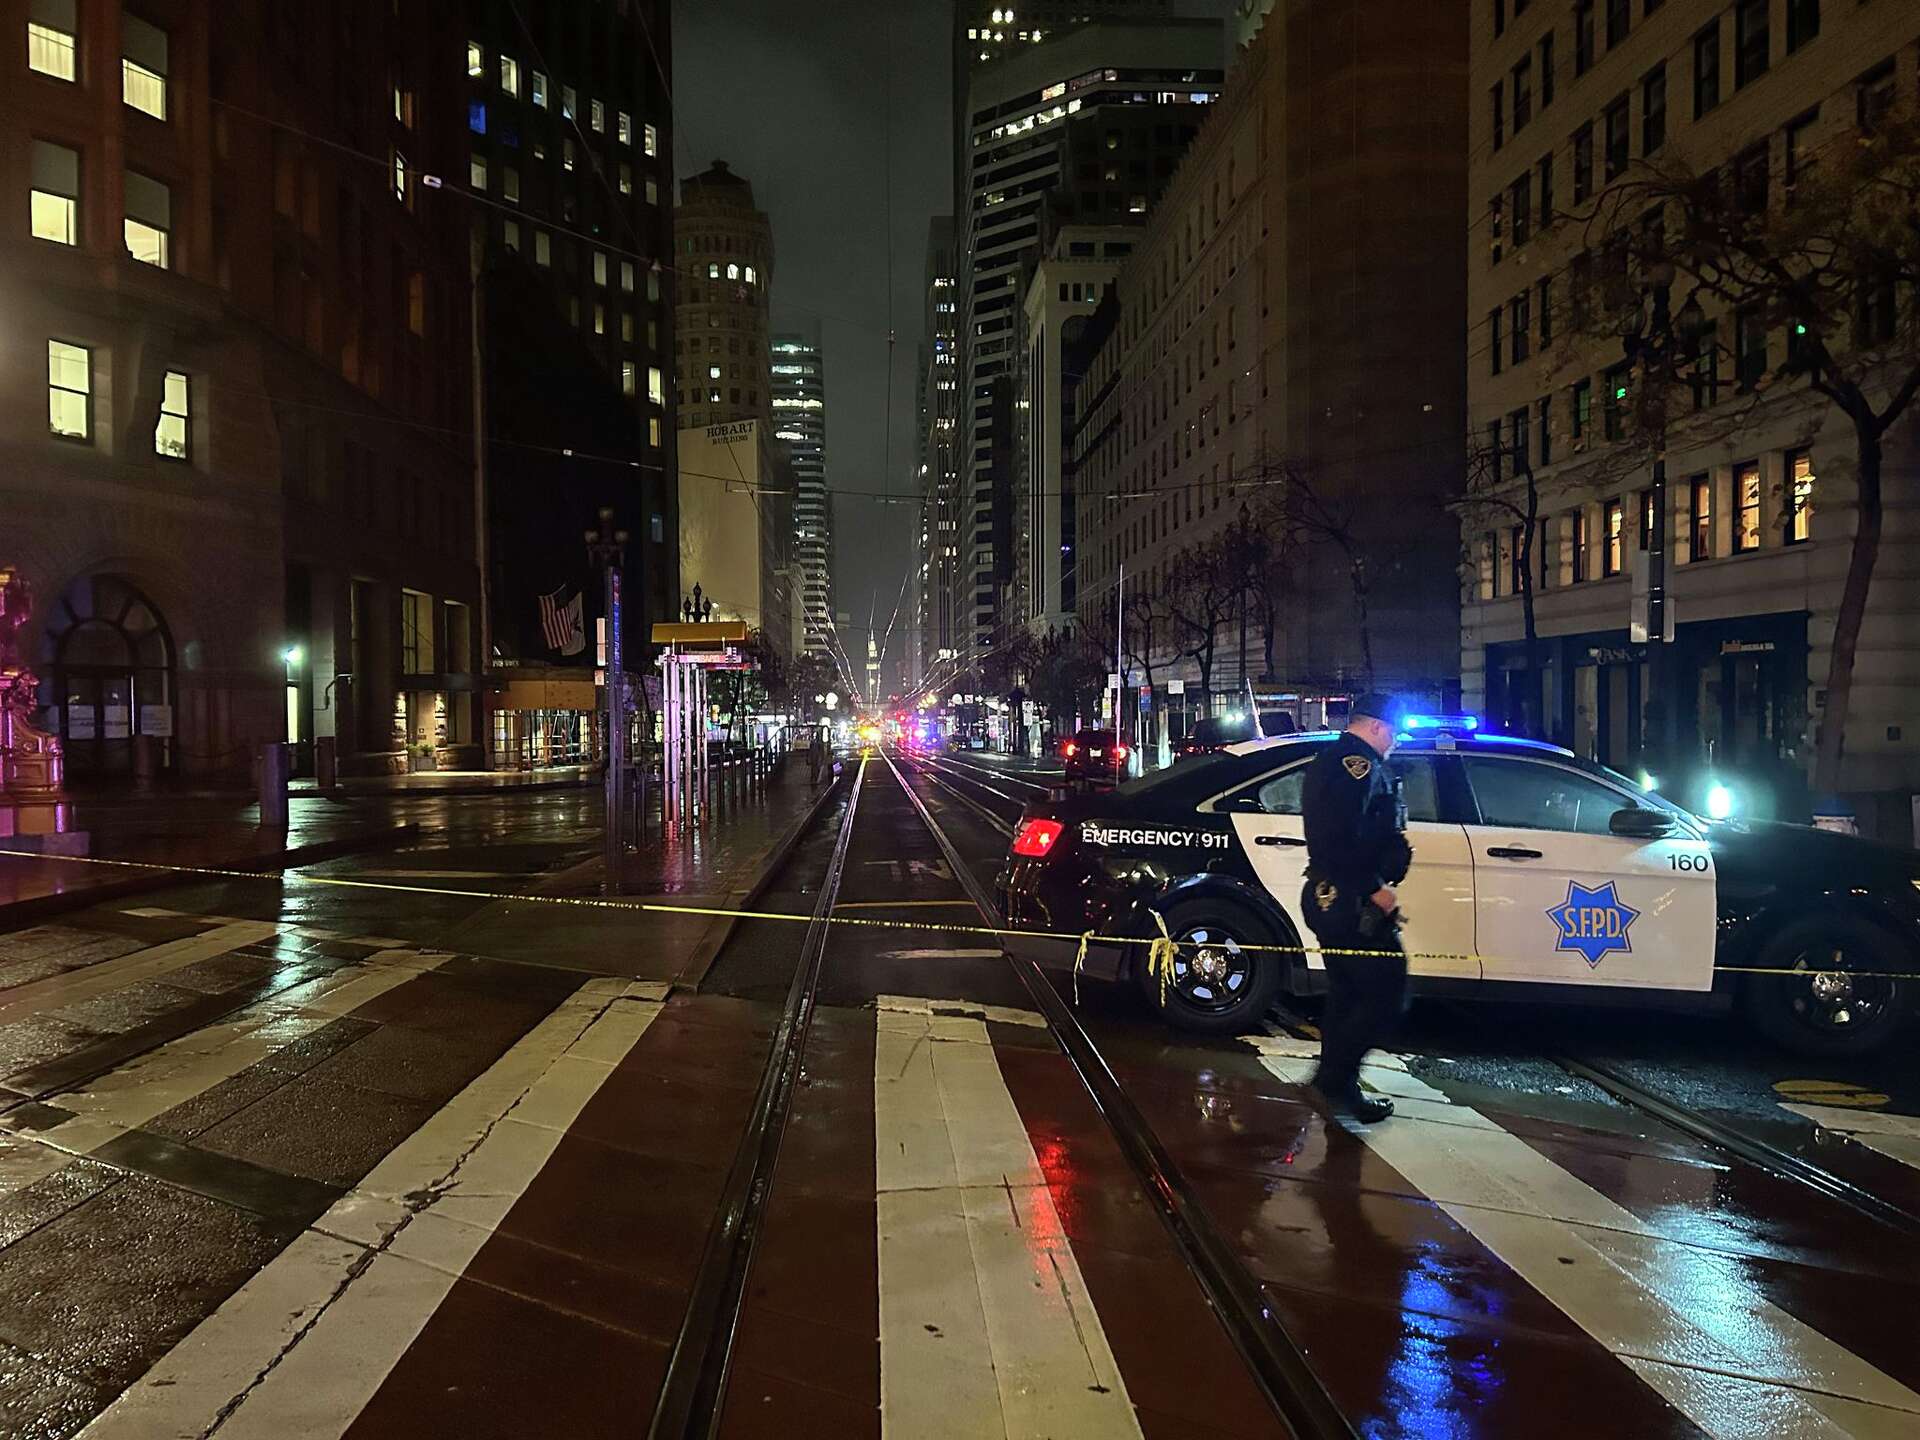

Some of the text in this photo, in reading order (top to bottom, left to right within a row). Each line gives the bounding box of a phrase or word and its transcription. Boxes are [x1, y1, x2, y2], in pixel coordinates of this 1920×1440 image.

[707, 422, 753, 437] HOBART
[1082, 828, 1194, 846] EMERGENCY
[1202, 833, 1229, 849] 911
[1667, 853, 1709, 872] 160
